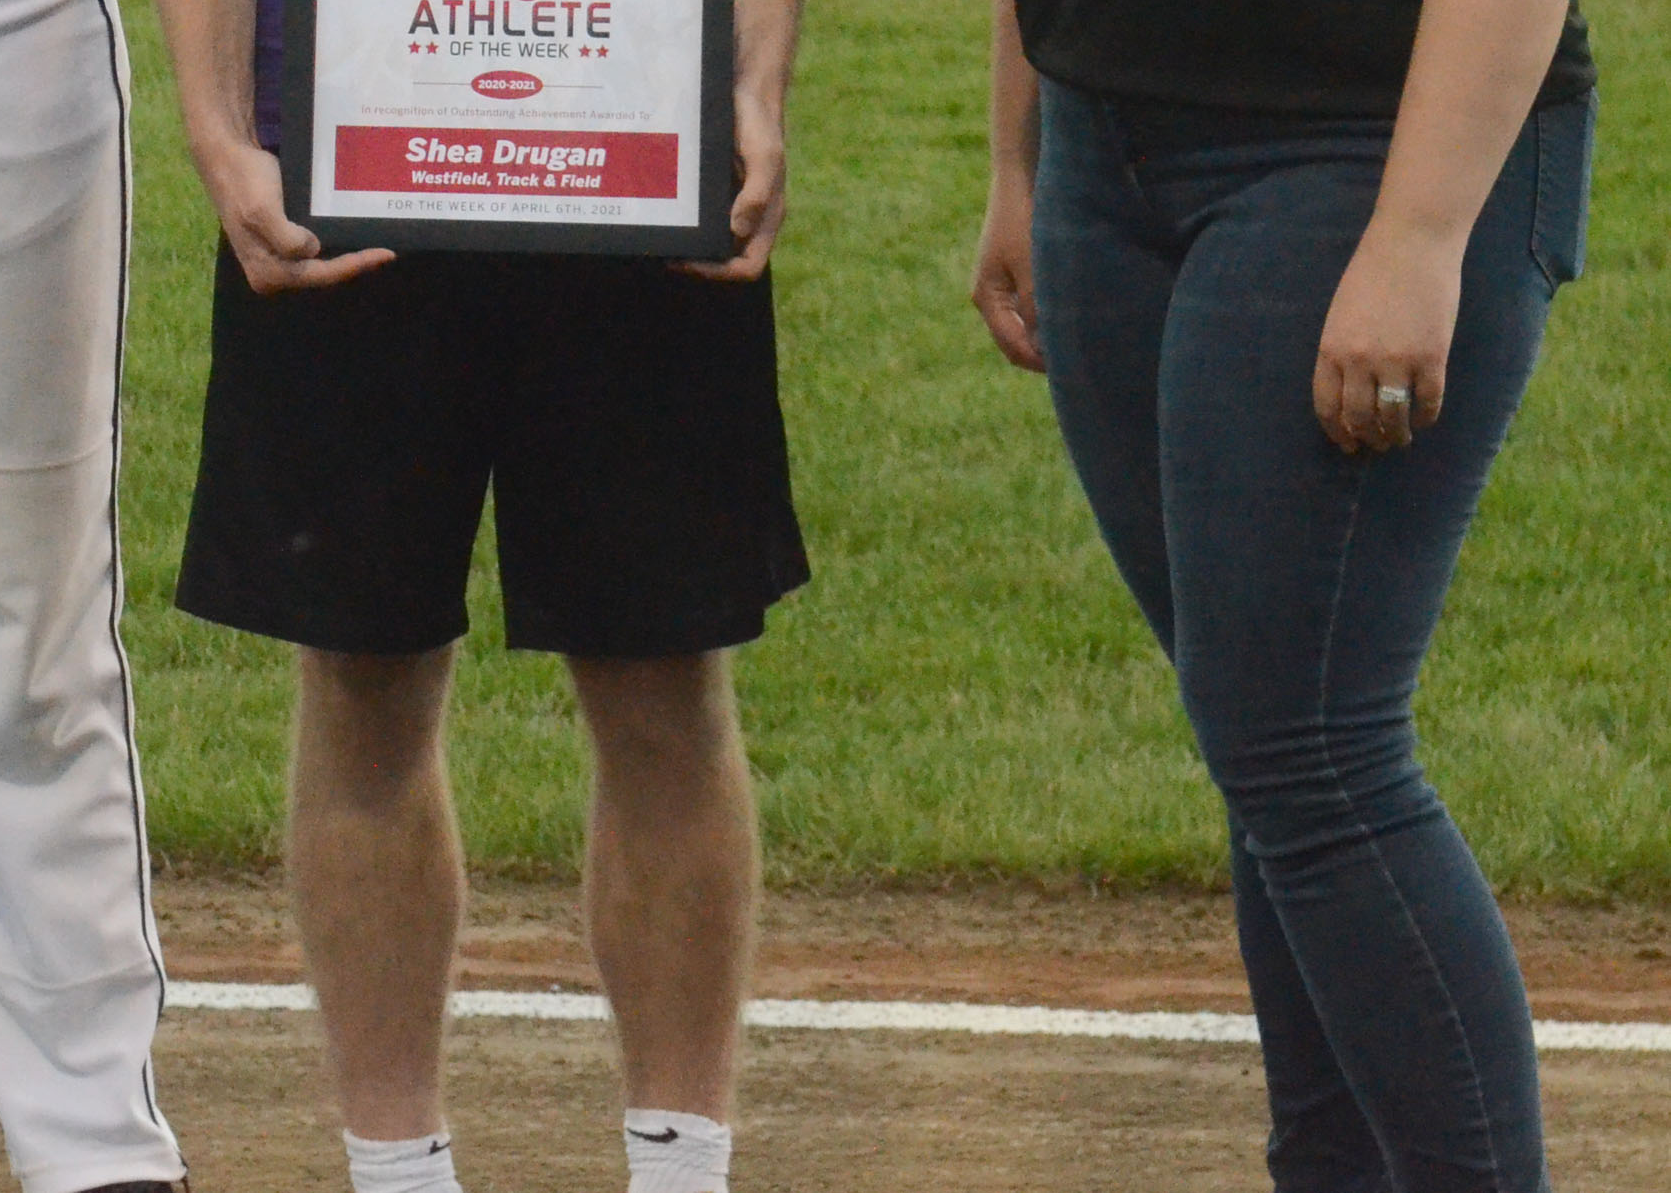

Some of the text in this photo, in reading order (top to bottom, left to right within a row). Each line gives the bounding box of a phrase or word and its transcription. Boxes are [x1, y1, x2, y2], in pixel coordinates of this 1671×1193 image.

[449, 40, 570, 59] OF THE WEEK
[477, 79, 537, 91] 2020-2021
[361, 105, 372, 114] In
[374, 105, 435, 119] recognition
[437, 106, 448, 116] of
[450, 107, 516, 119] Outstanding
[518, 108, 586, 119] Achievement
[590, 109, 636, 120] Awarded
[405, 136, 607, 171] Shea Drugan
[411, 170, 602, 189] Westfield, Track & Field
[387, 199, 413, 210] FOR
[418, 200, 443, 211] THE
[447, 201, 485, 212] WEEK
[490, 201, 507, 212] OF
[512, 202, 550, 214] APRIL
[591, 205, 622, 216] 2021
